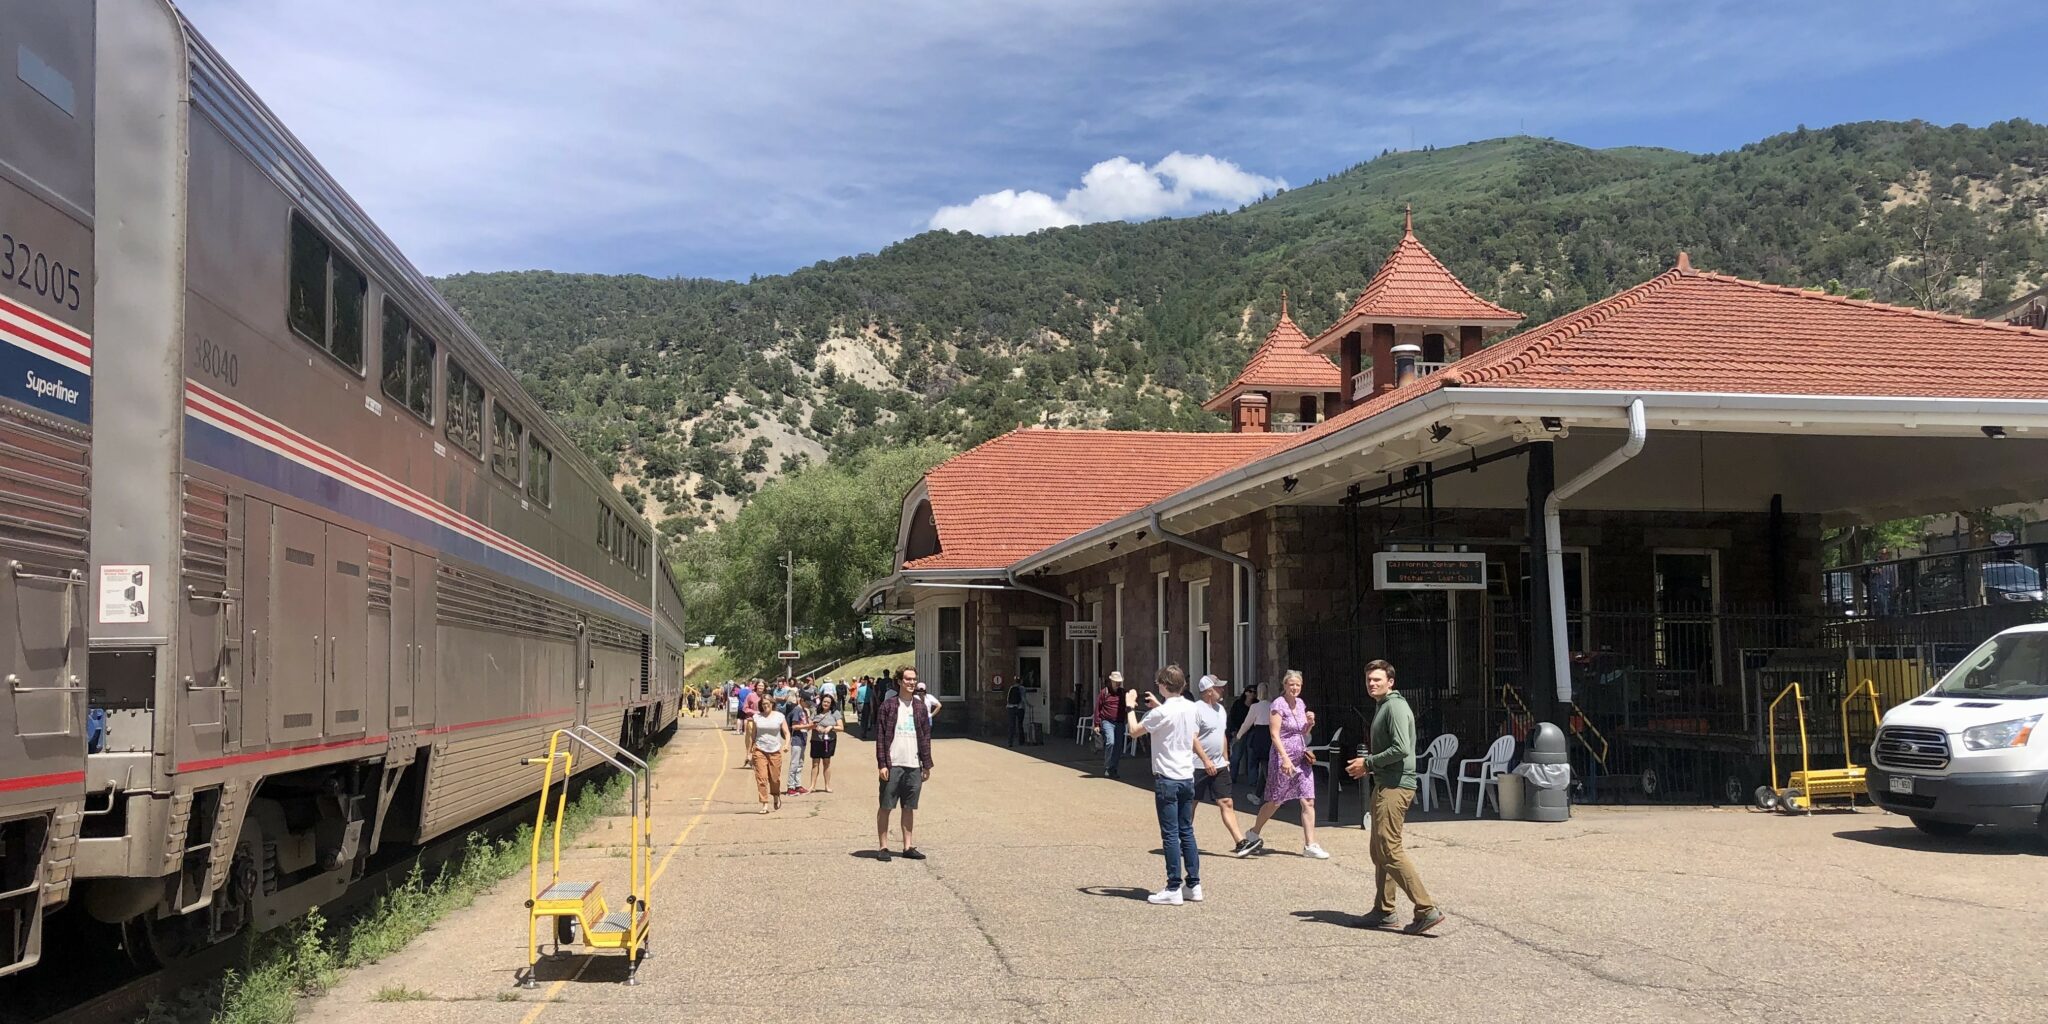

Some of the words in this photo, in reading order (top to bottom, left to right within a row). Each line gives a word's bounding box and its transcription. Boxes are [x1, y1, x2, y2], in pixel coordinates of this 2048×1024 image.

[2, 233, 80, 311] 32005
[192, 332, 238, 387] 38040
[25, 370, 79, 405] Superliner
